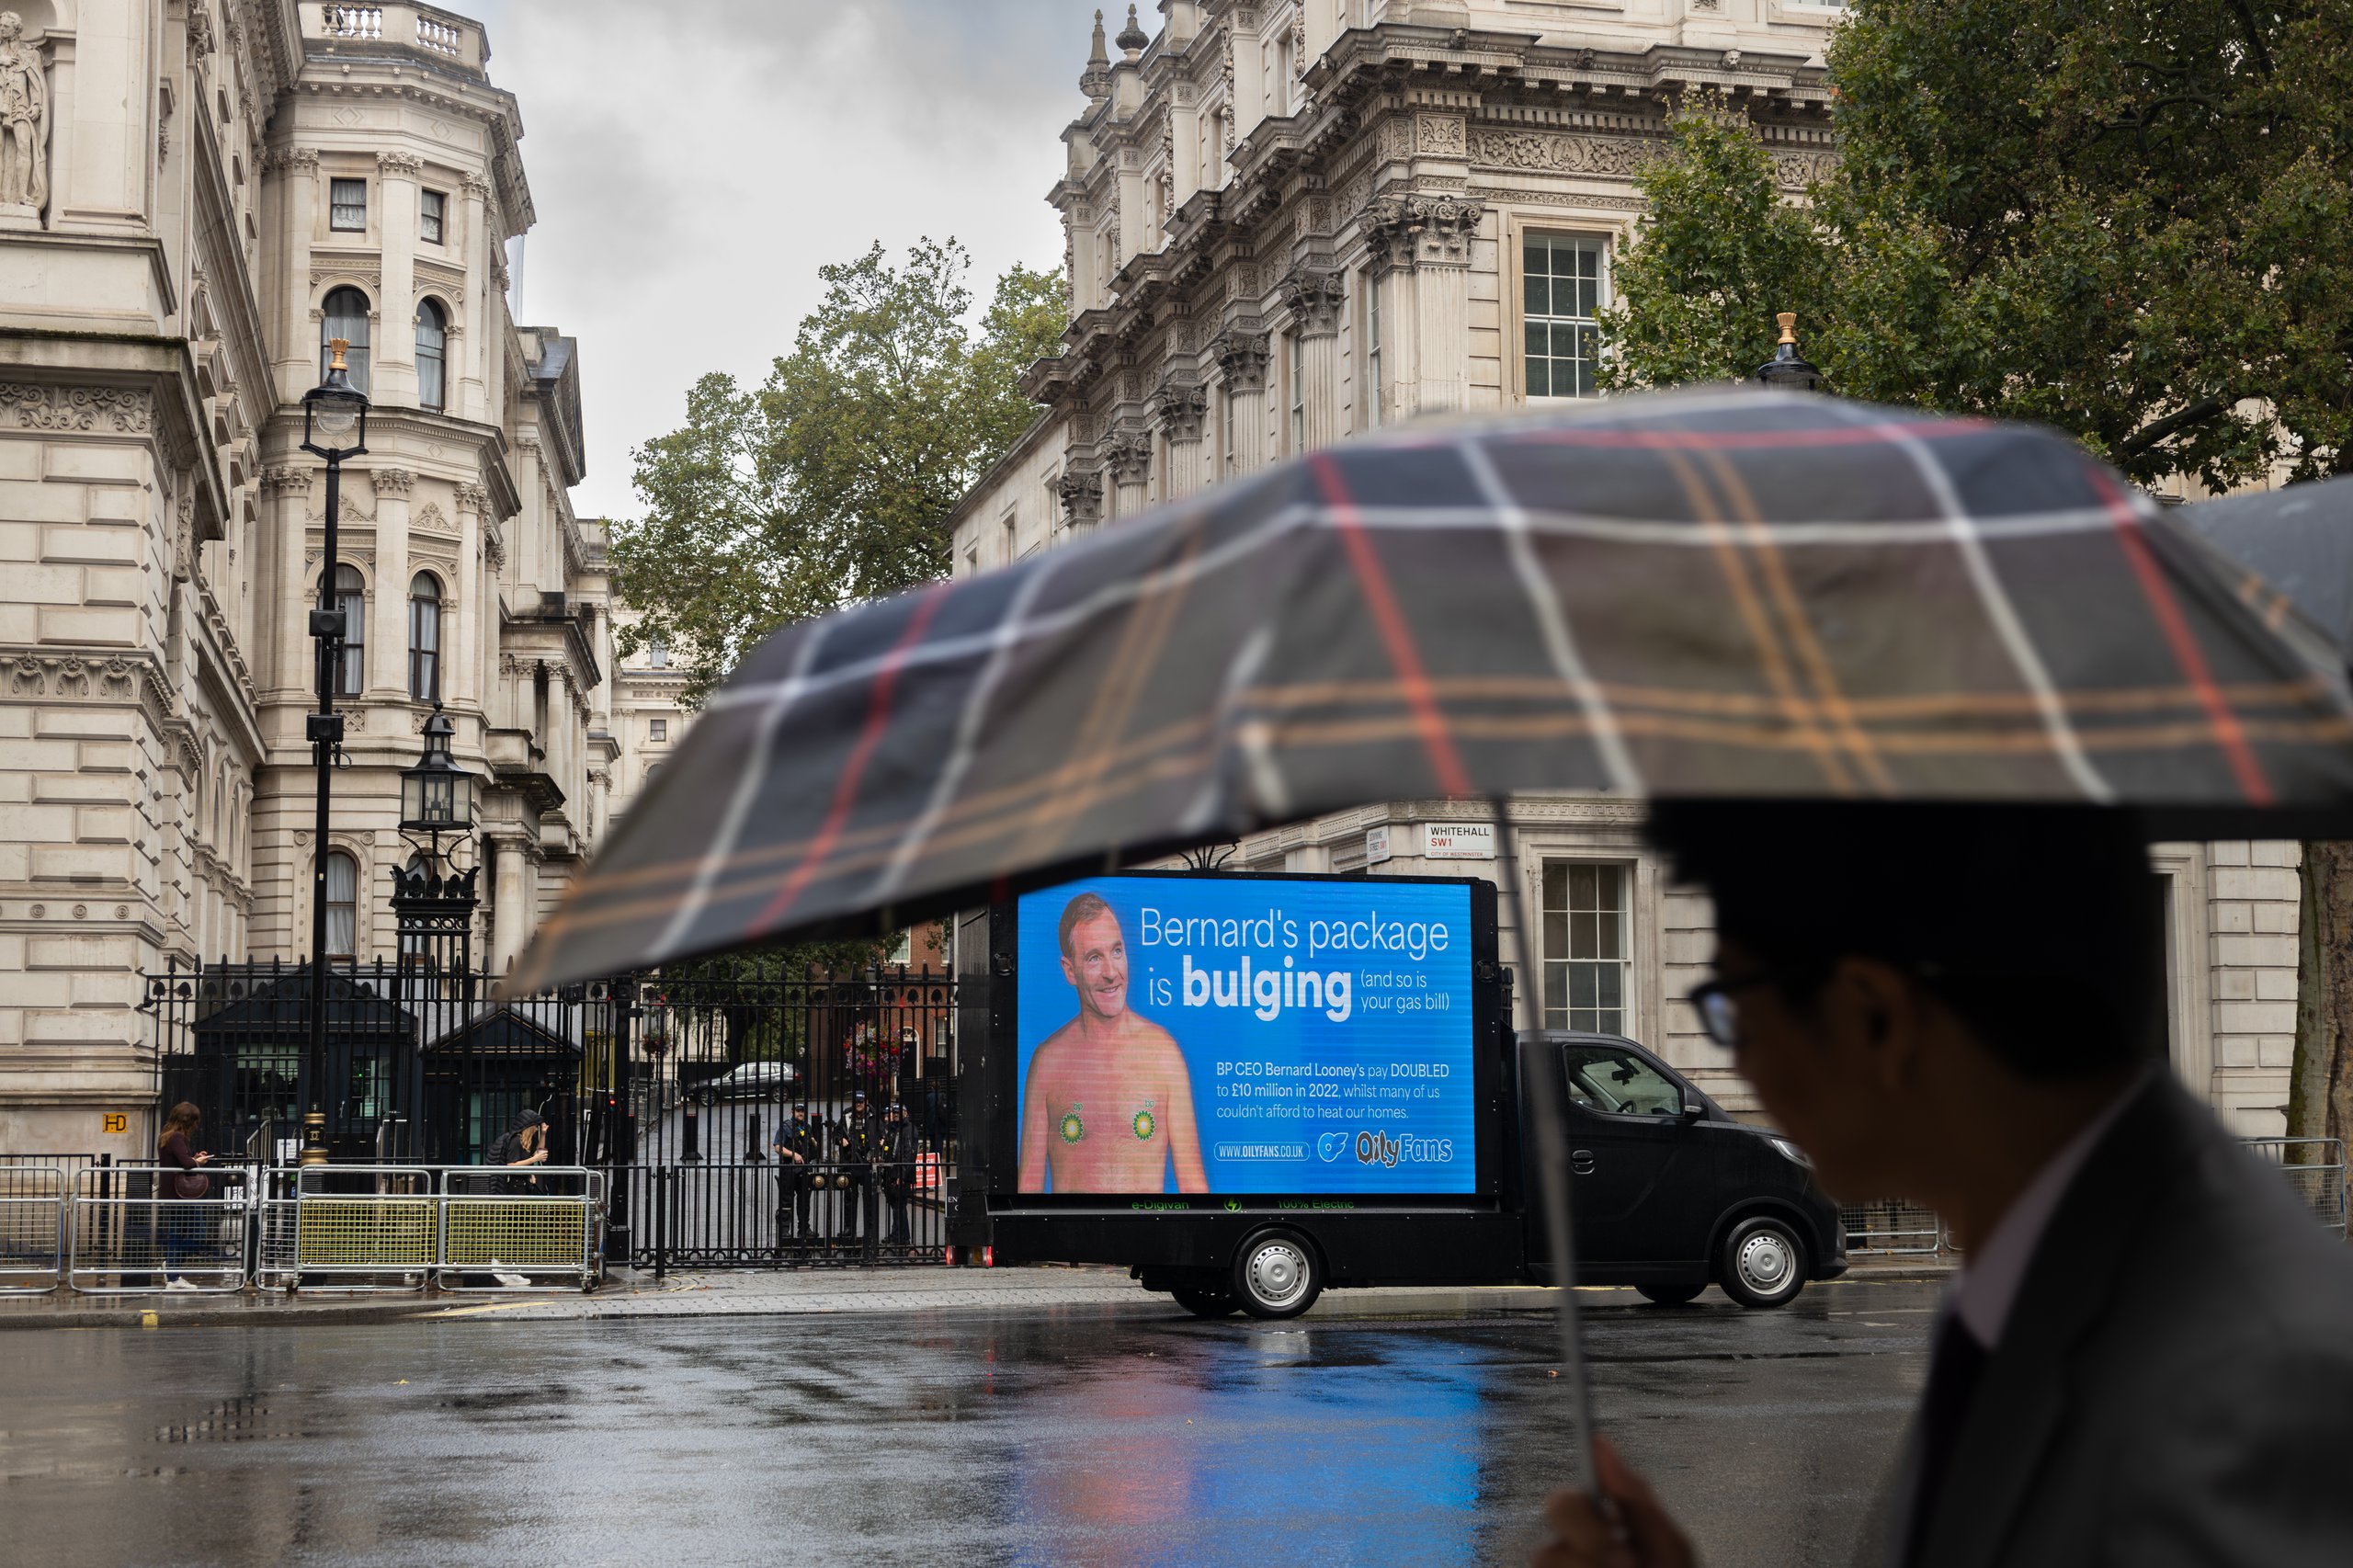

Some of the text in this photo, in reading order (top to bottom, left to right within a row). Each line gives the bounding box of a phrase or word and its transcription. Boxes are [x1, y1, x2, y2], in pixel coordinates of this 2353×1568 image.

[1430, 826, 1490, 836] WHITEHALL
[1430, 837, 1452, 846] SW1
[1142, 908, 1449, 960] Bernard's package
[1361, 969, 1427, 988] (and so is
[1148, 955, 1352, 1022] is bulging
[1360, 993, 1449, 1013] your gas bill)
[1216, 1062, 1449, 1081] BP CEO Bernard Looney's pay DOUBLED
[1216, 1083, 1440, 1101] to £10 million in 2022, whilst many of us
[1216, 1104, 1409, 1119] couldn't afford to heat our homes.
[1219, 1145, 1303, 1158] WWW.OILYFANS.CO.UK
[1356, 1130, 1453, 1168] OilyFans
[1131, 1199, 1189, 1211] e-Digivan
[1278, 1199, 1354, 1208] 100% Electric
